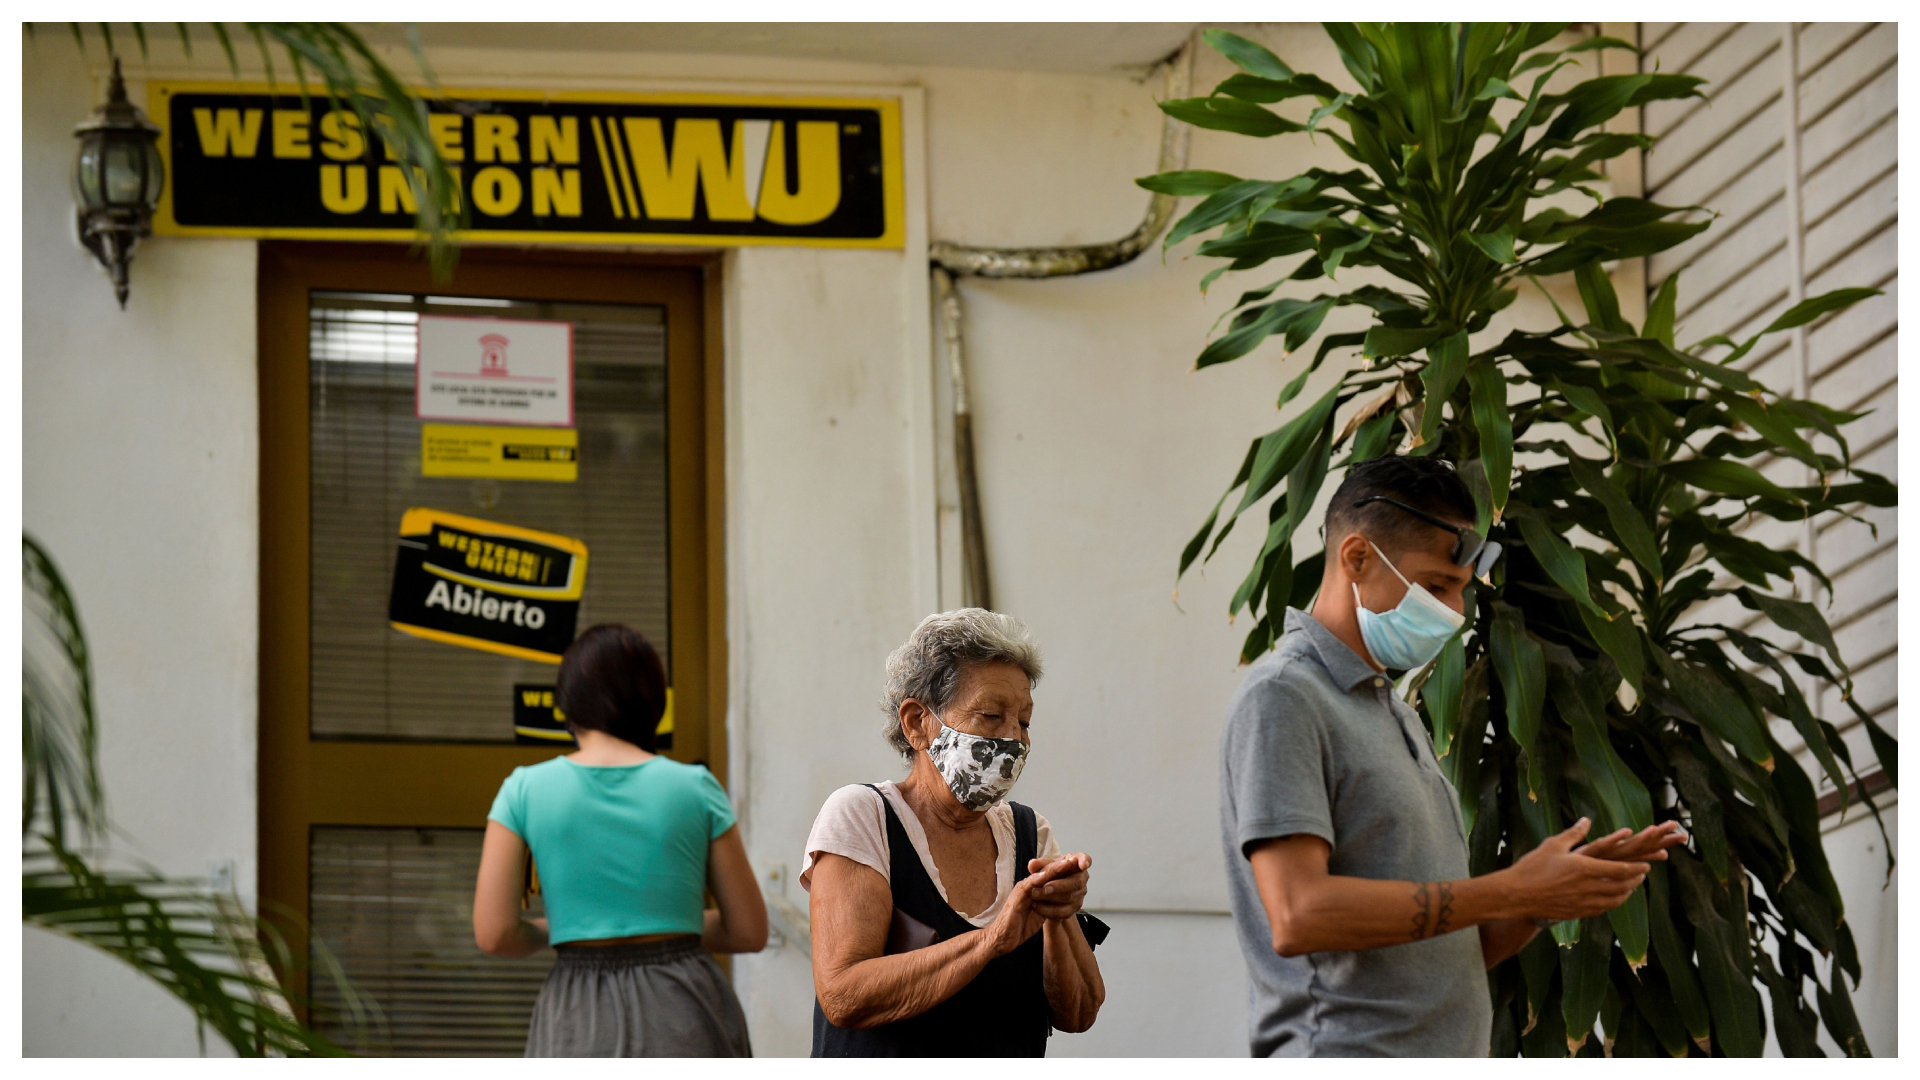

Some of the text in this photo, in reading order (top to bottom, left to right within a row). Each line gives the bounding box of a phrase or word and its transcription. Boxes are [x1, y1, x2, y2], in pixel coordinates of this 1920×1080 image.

[622, 117, 842, 226] WU
[437, 530, 535, 565] WESTERN
[465, 551, 533, 582] UNION
[424, 579, 547, 630] Abierto
